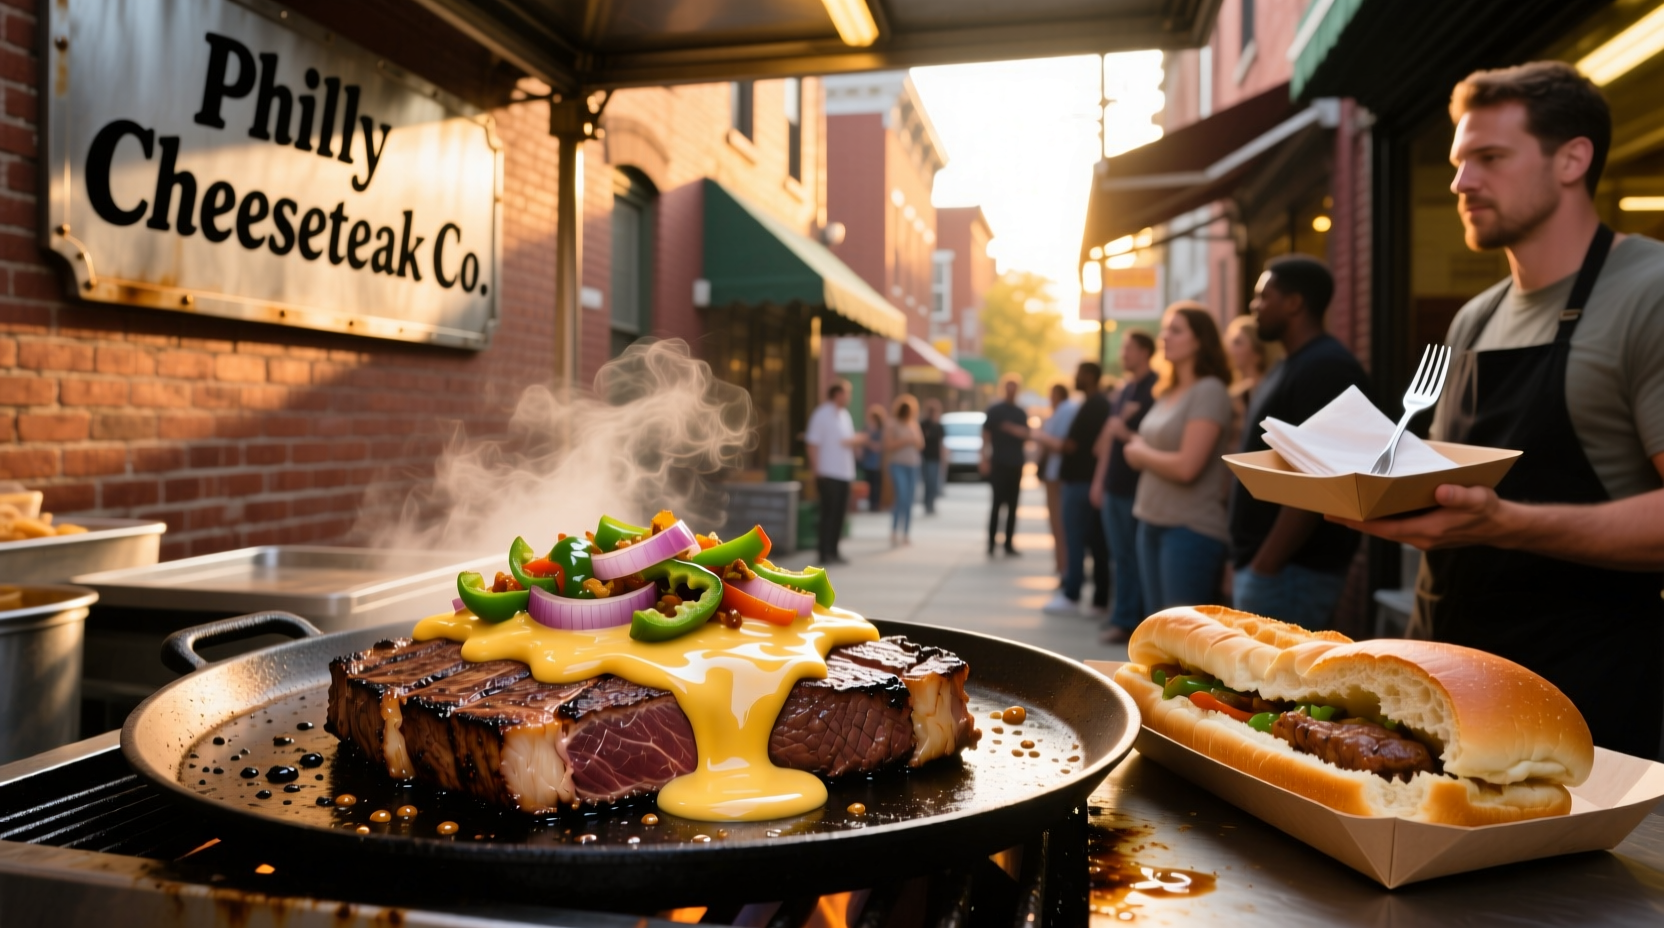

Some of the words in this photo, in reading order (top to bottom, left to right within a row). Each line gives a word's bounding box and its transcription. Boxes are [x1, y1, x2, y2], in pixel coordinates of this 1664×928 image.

[194, 32, 391, 192] Philly
[85, 119, 424, 281] Cheeseteak
[433, 223, 488, 296] Co.
